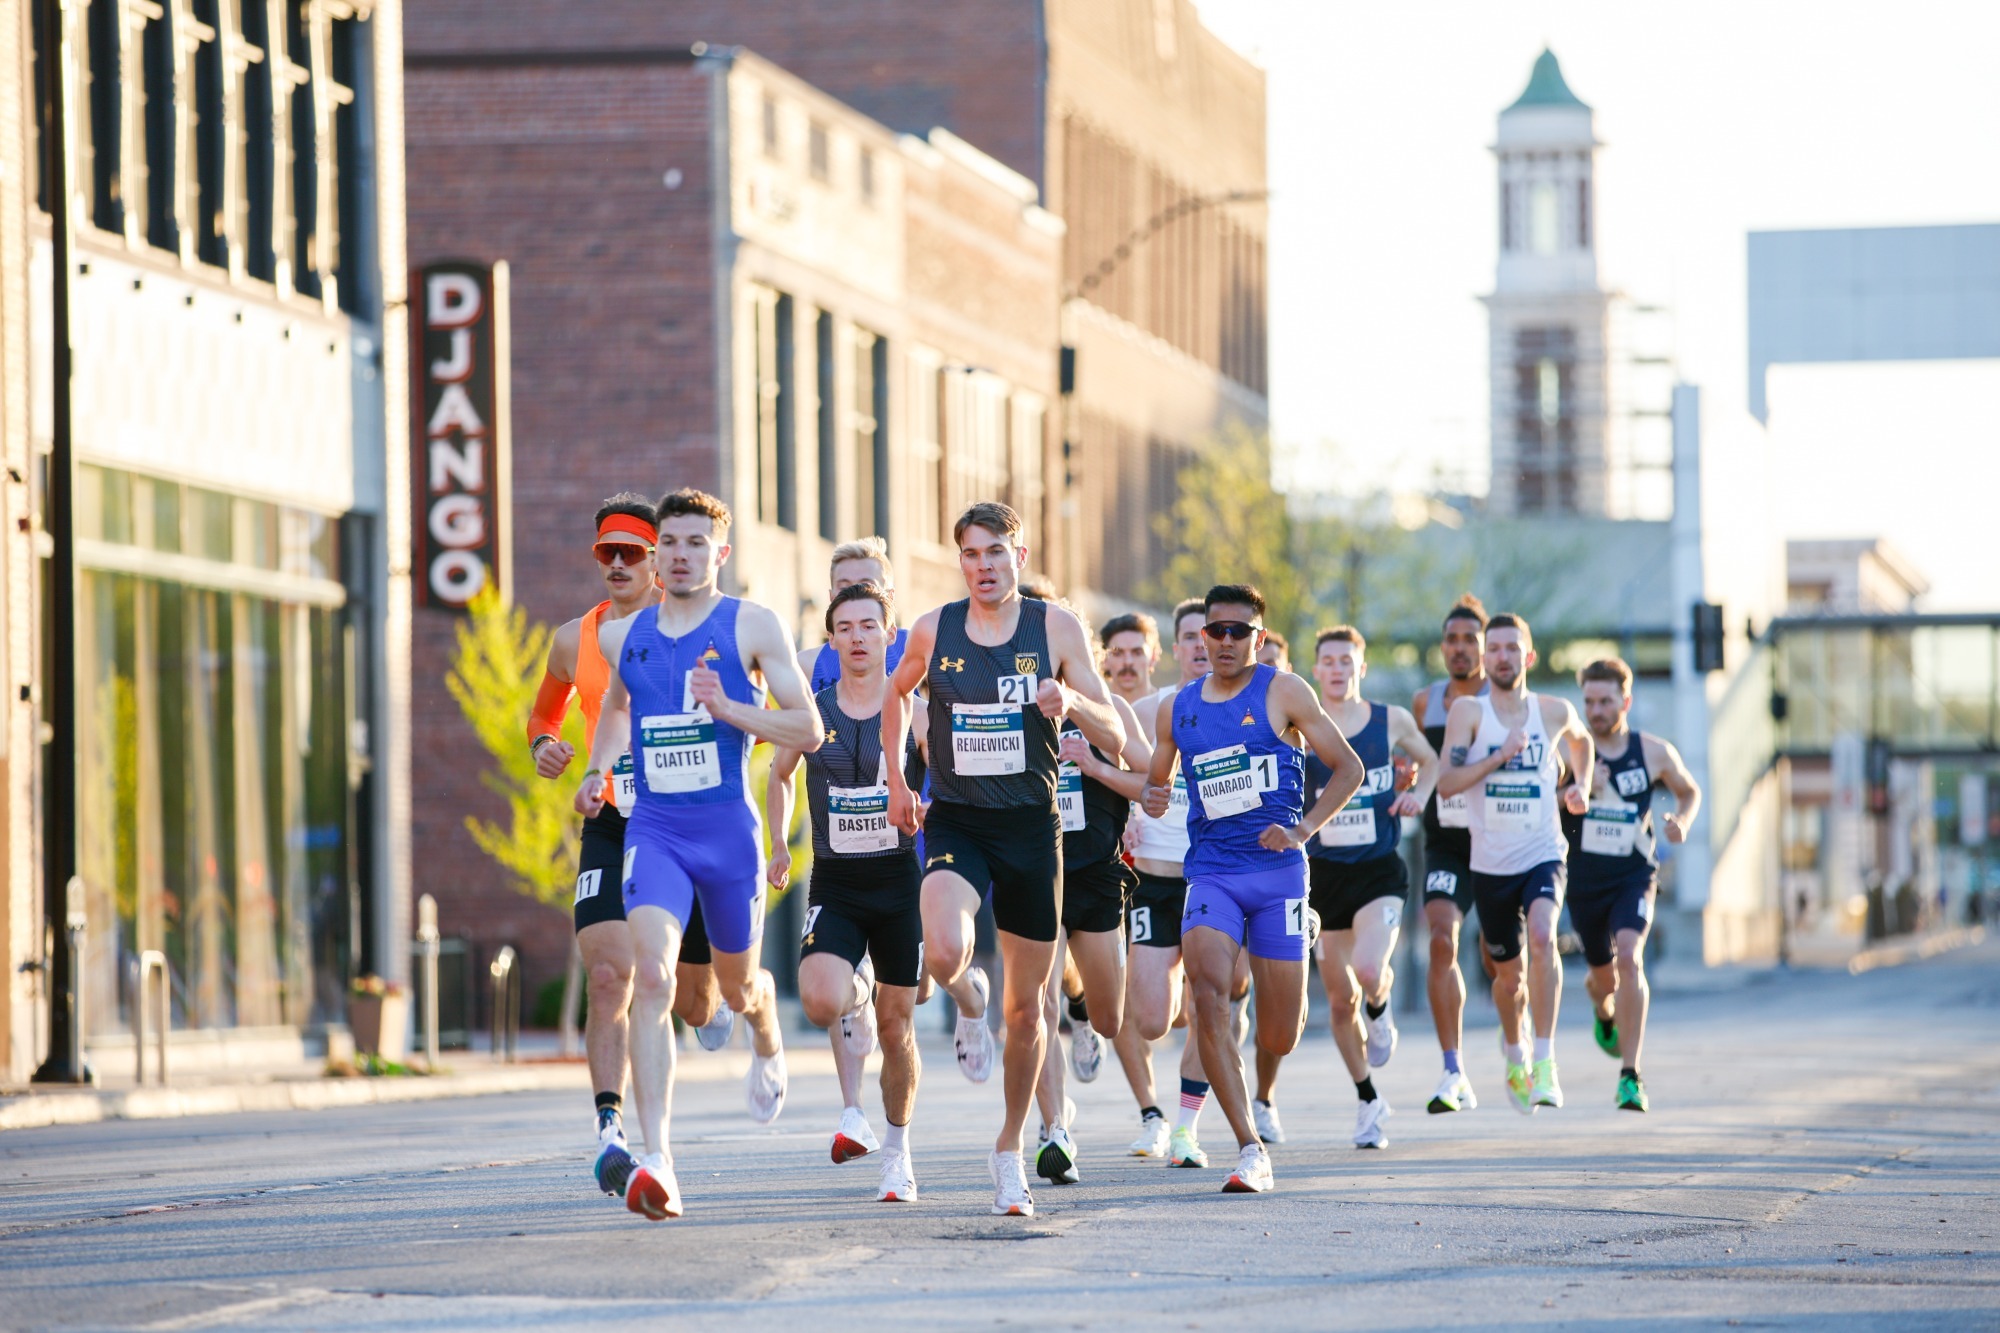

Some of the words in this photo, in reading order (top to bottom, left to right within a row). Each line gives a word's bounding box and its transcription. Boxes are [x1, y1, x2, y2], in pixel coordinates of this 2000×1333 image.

[427, 272, 486, 604] DJANGO
[1001, 676, 1029, 703] 21
[956, 735, 1020, 752] RENIEWICKI
[1527, 743, 1543, 763] 17
[655, 749, 706, 768] CIATTEI
[1257, 758, 1271, 788] 1
[1374, 769, 1389, 791] 27
[1202, 774, 1253, 799] ALVARADO
[1497, 802, 1529, 814] MAIER
[838, 816, 887, 832] BASTEN
[579, 873, 592, 899] 11
[1136, 910, 1146, 939] 5
